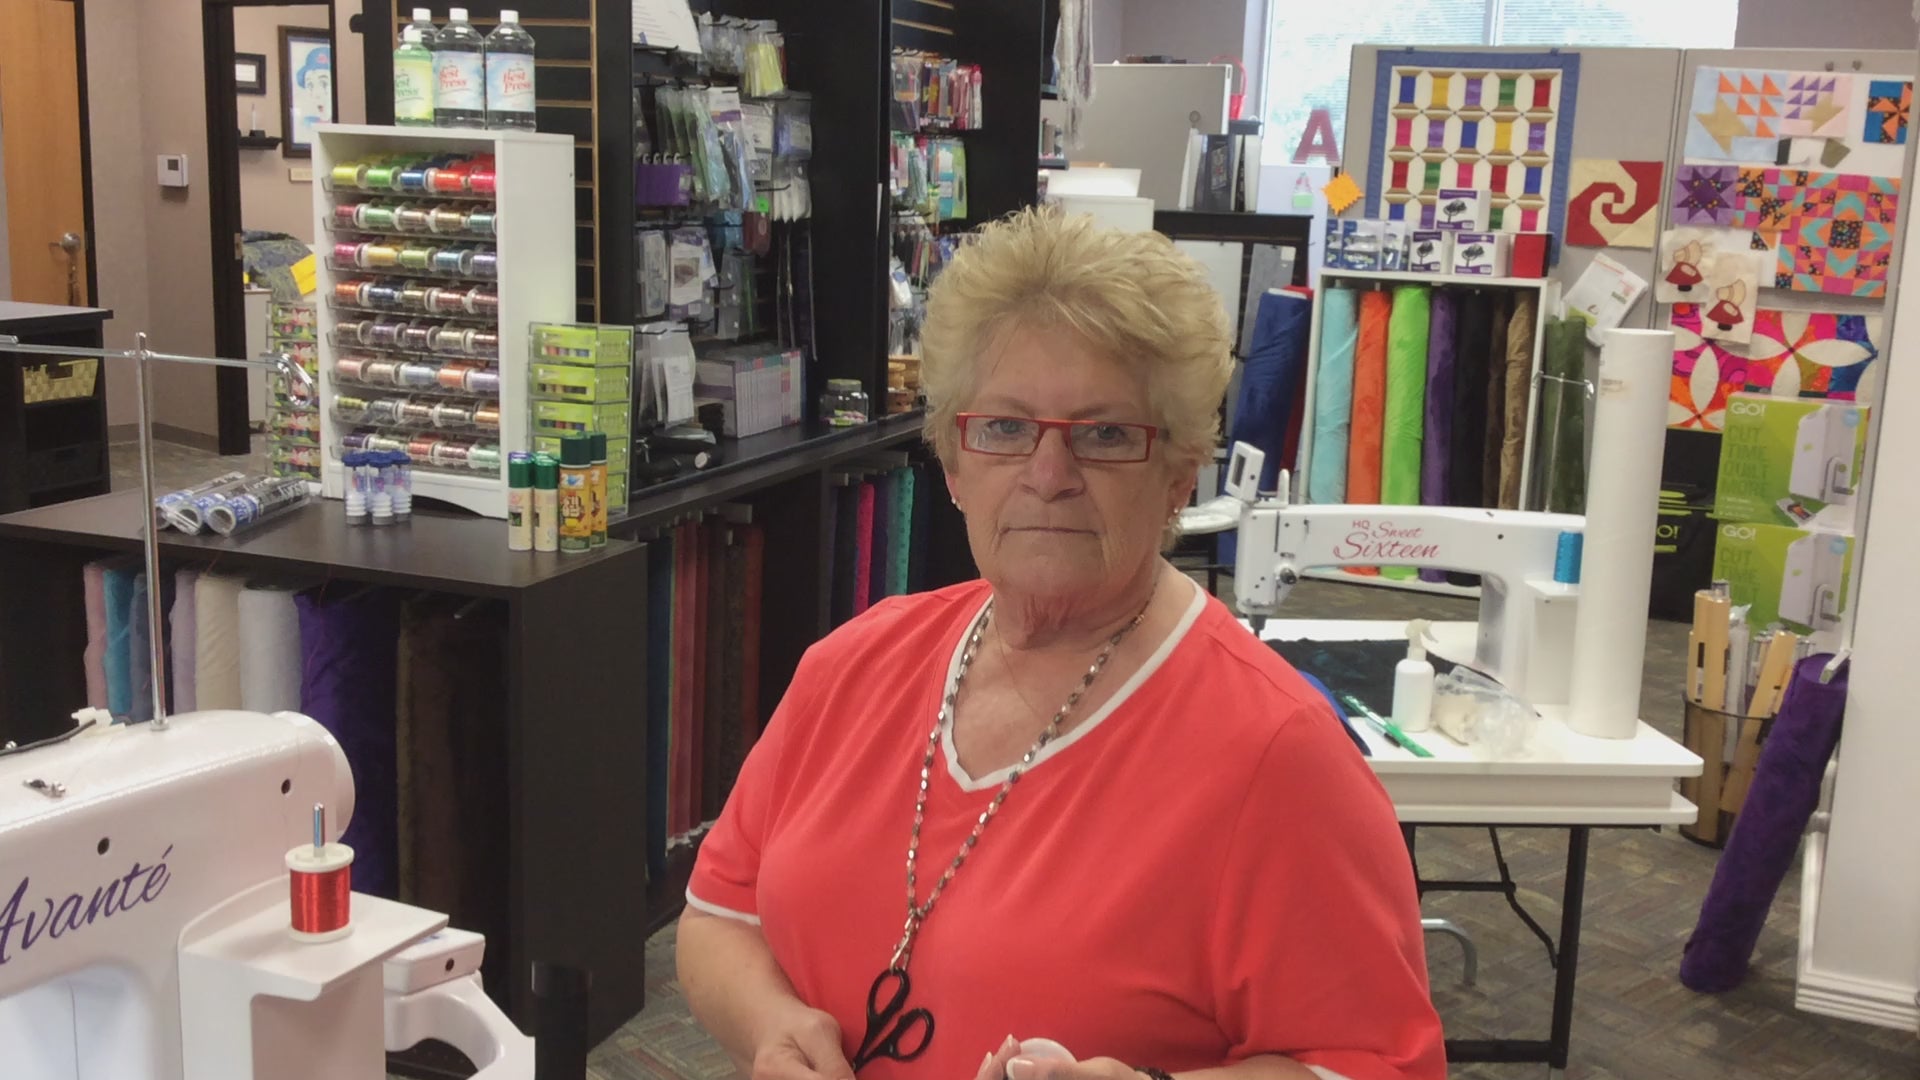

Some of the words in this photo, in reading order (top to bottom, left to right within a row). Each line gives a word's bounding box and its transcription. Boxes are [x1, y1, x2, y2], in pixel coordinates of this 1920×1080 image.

[503, 71, 526, 81] Best
[439, 79, 467, 90] Press
[504, 81, 532, 94] Press
[1290, 107, 1341, 165] A
[1730, 402, 1766, 416] GO!
[1352, 519, 1370, 530] HQ
[1372, 521, 1423, 539] Sweet
[1656, 524, 1679, 539] O!
[1722, 525, 1756, 540] GO!
[1333, 531, 1440, 560] Sixteen
[0, 844, 173, 965] Avanté
